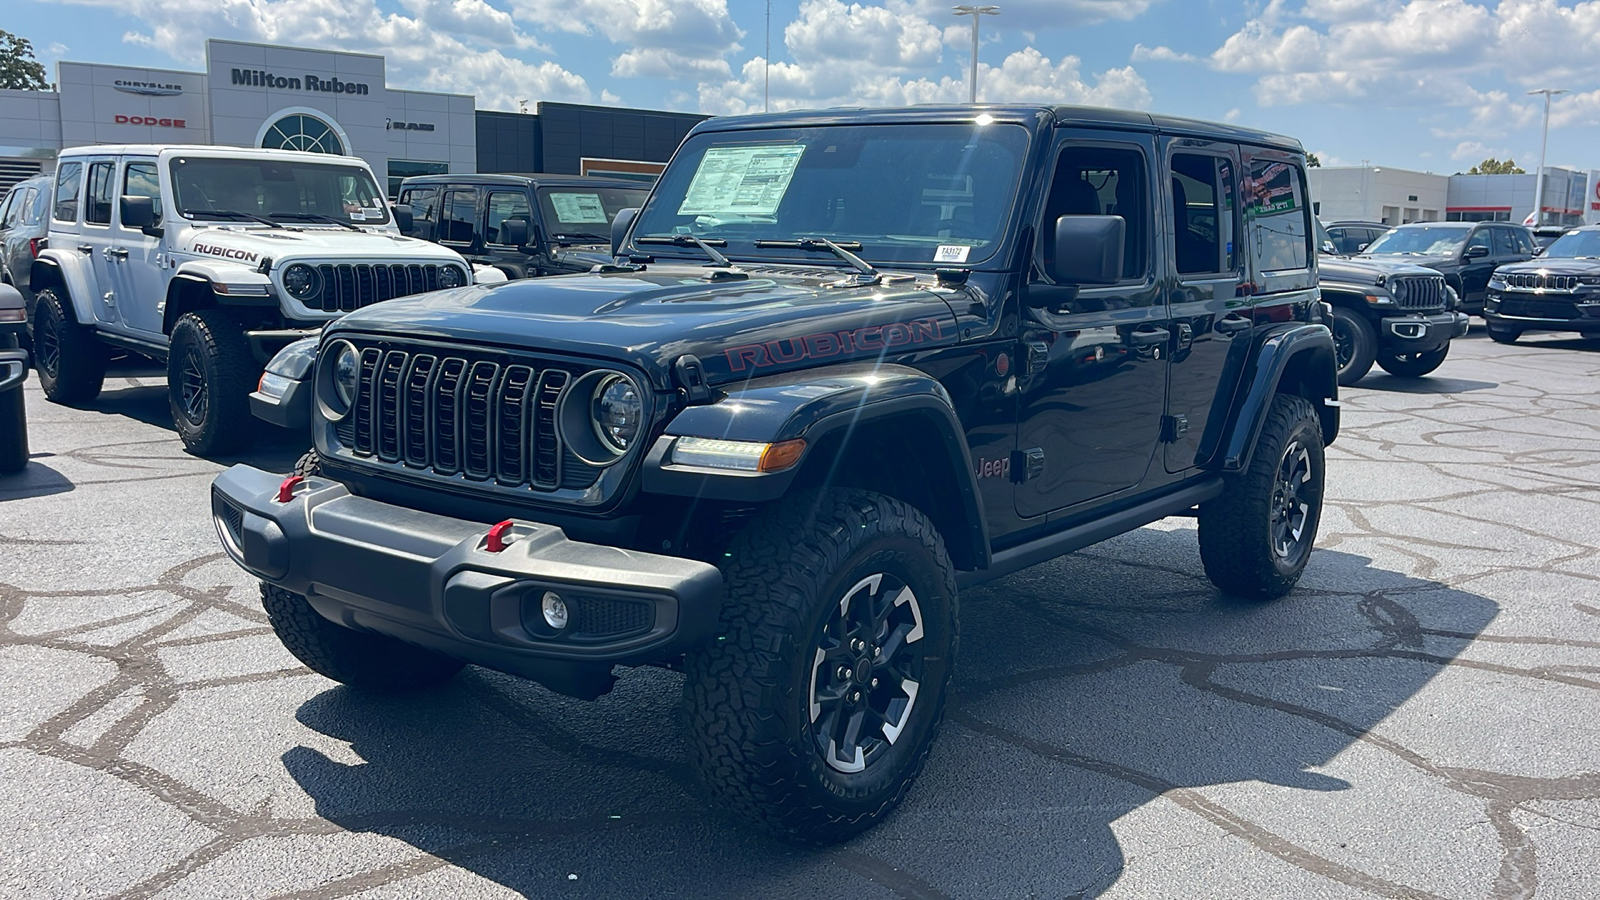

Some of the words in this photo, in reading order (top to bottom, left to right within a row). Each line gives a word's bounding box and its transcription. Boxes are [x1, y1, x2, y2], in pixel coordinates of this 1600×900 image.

[114, 80, 182, 90] CHRYSLER
[231, 68, 301, 90] Milton
[304, 74, 369, 95] Ruben
[115, 114, 186, 128] DODGE
[393, 121, 435, 132] RAM
[193, 243, 259, 262] RUBICON
[724, 319, 942, 372] RUBICON
[975, 457, 1010, 480] Jeep
